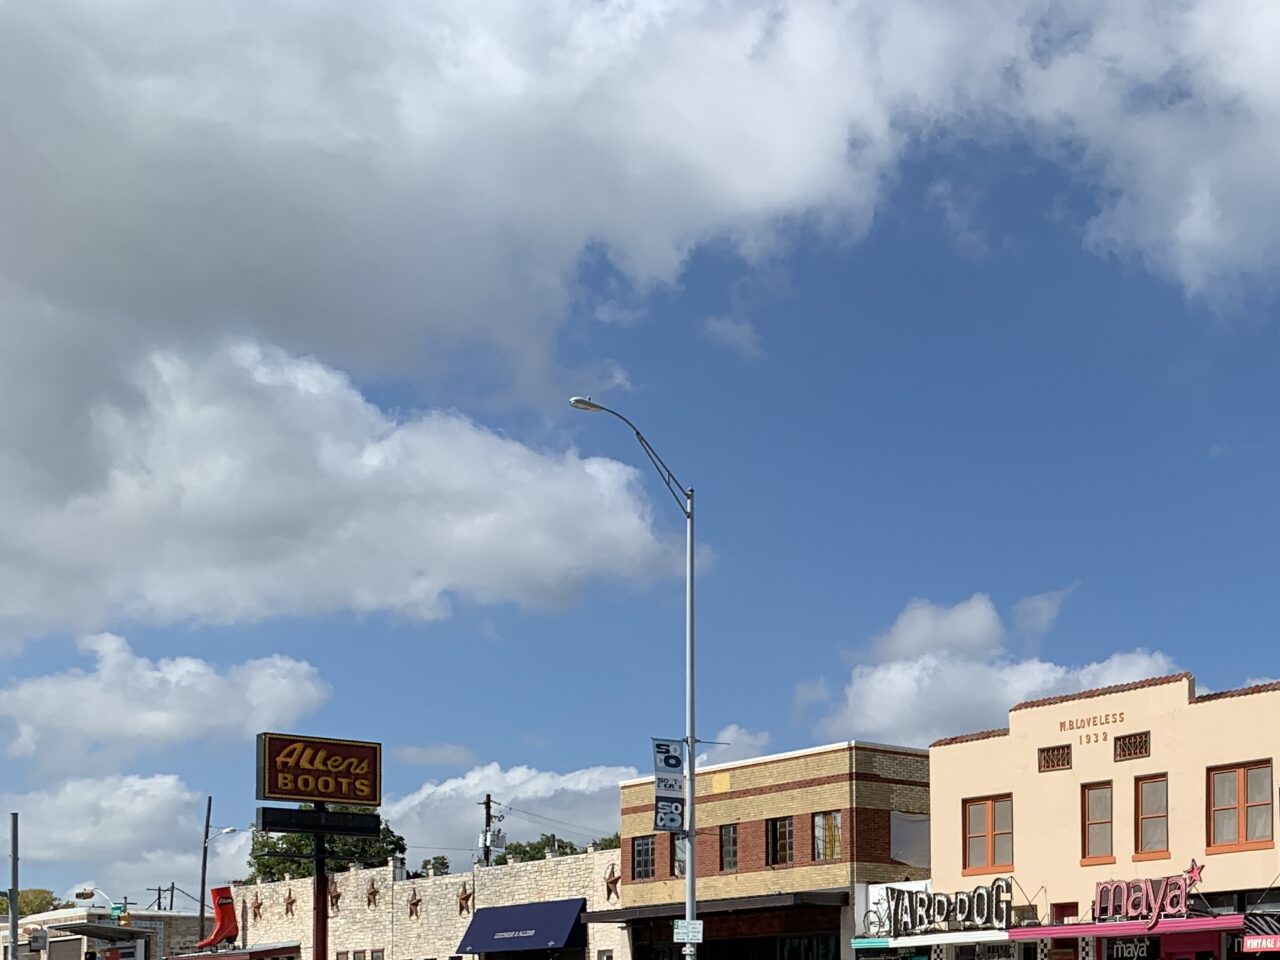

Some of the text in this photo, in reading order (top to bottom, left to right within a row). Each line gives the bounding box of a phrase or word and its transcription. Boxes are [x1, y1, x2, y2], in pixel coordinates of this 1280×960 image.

[277, 772, 372, 797] BOOTS
[658, 801, 682, 814] SO
[656, 812, 682, 827] CO
[886, 877, 1012, 938] YARD DOG
[1095, 876, 1189, 929] maya
[1246, 937, 1275, 949] VINTAGE
